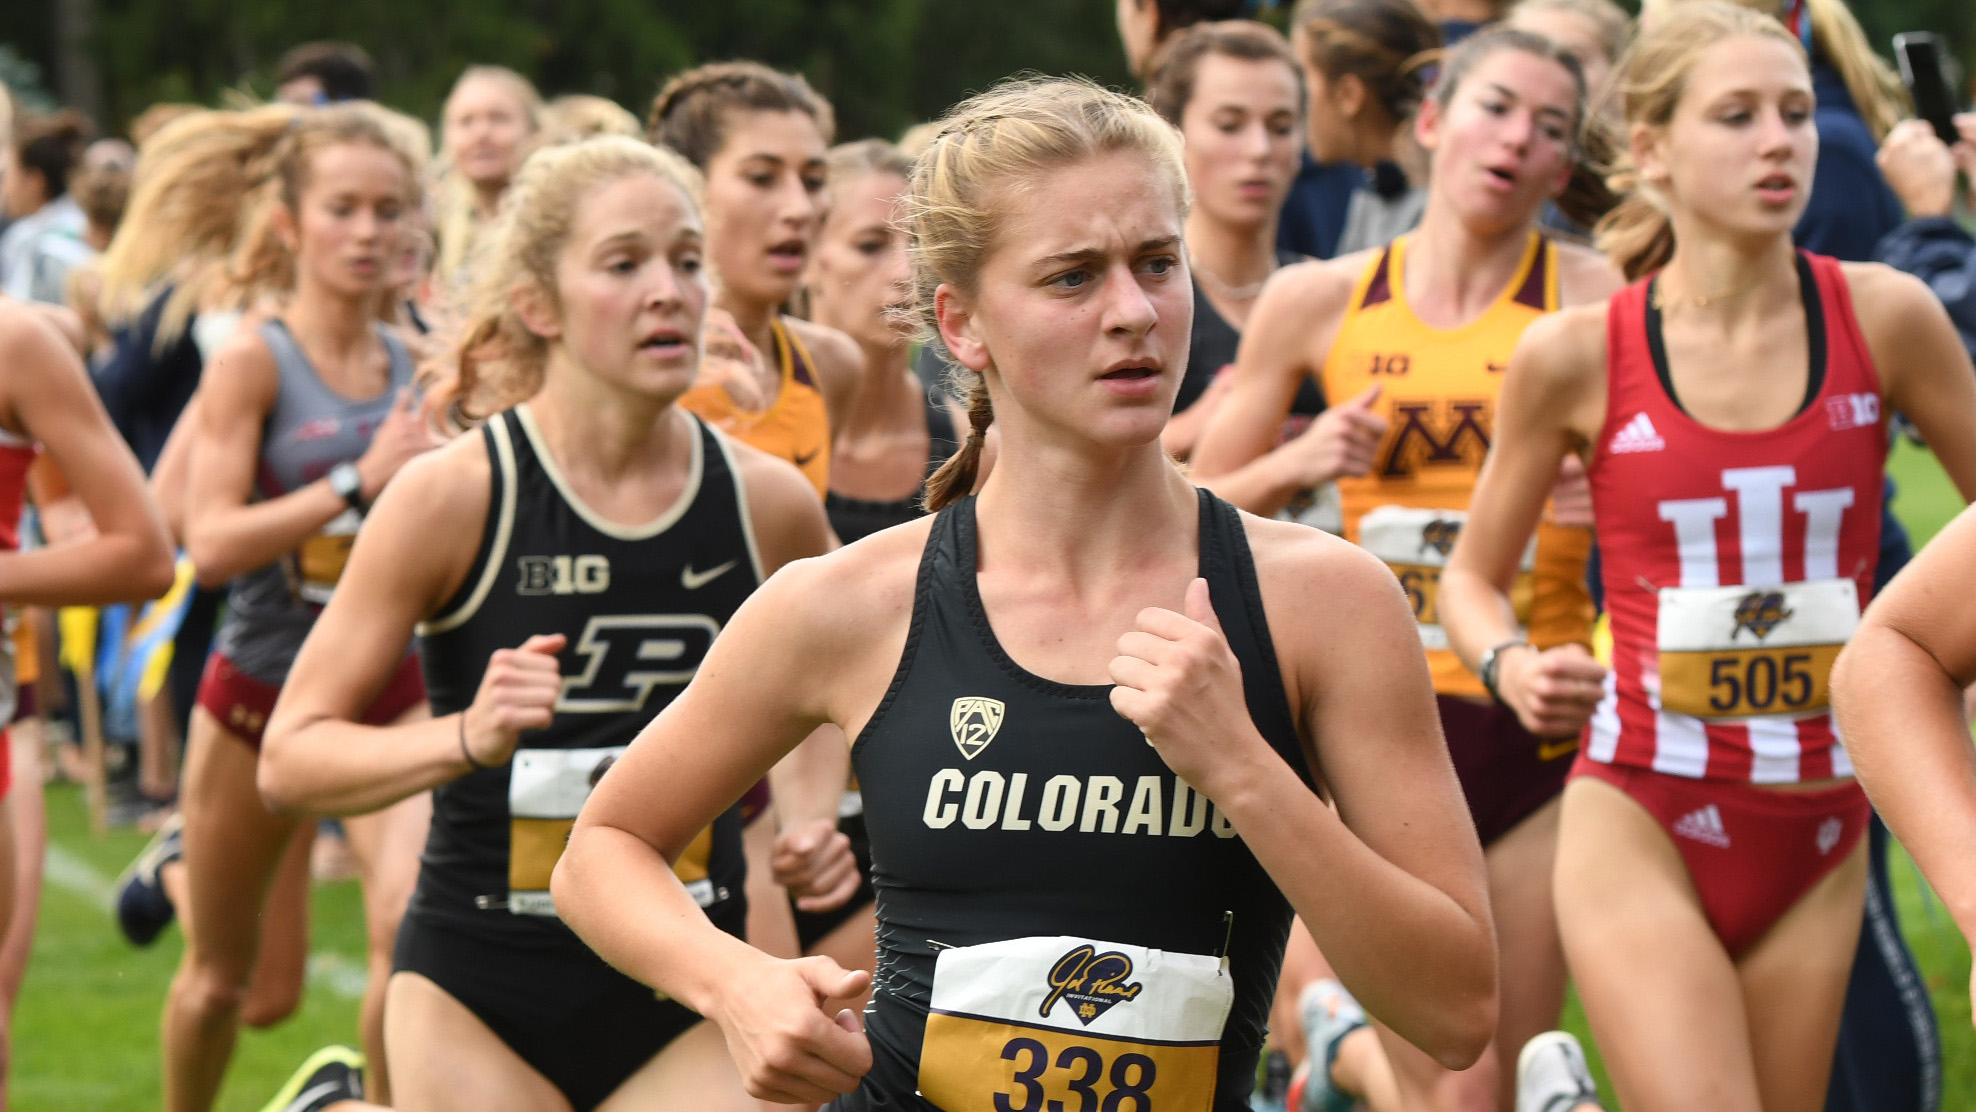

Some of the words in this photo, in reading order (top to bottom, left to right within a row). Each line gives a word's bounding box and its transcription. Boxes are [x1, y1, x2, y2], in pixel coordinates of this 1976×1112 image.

[555, 614, 721, 713] P
[1709, 653, 1813, 712] 505
[954, 699, 1001, 735] PAC
[960, 723, 987, 746] 12
[1065, 992, 1113, 1004] INVITATIONAL
[993, 1037, 1156, 1112] 338
